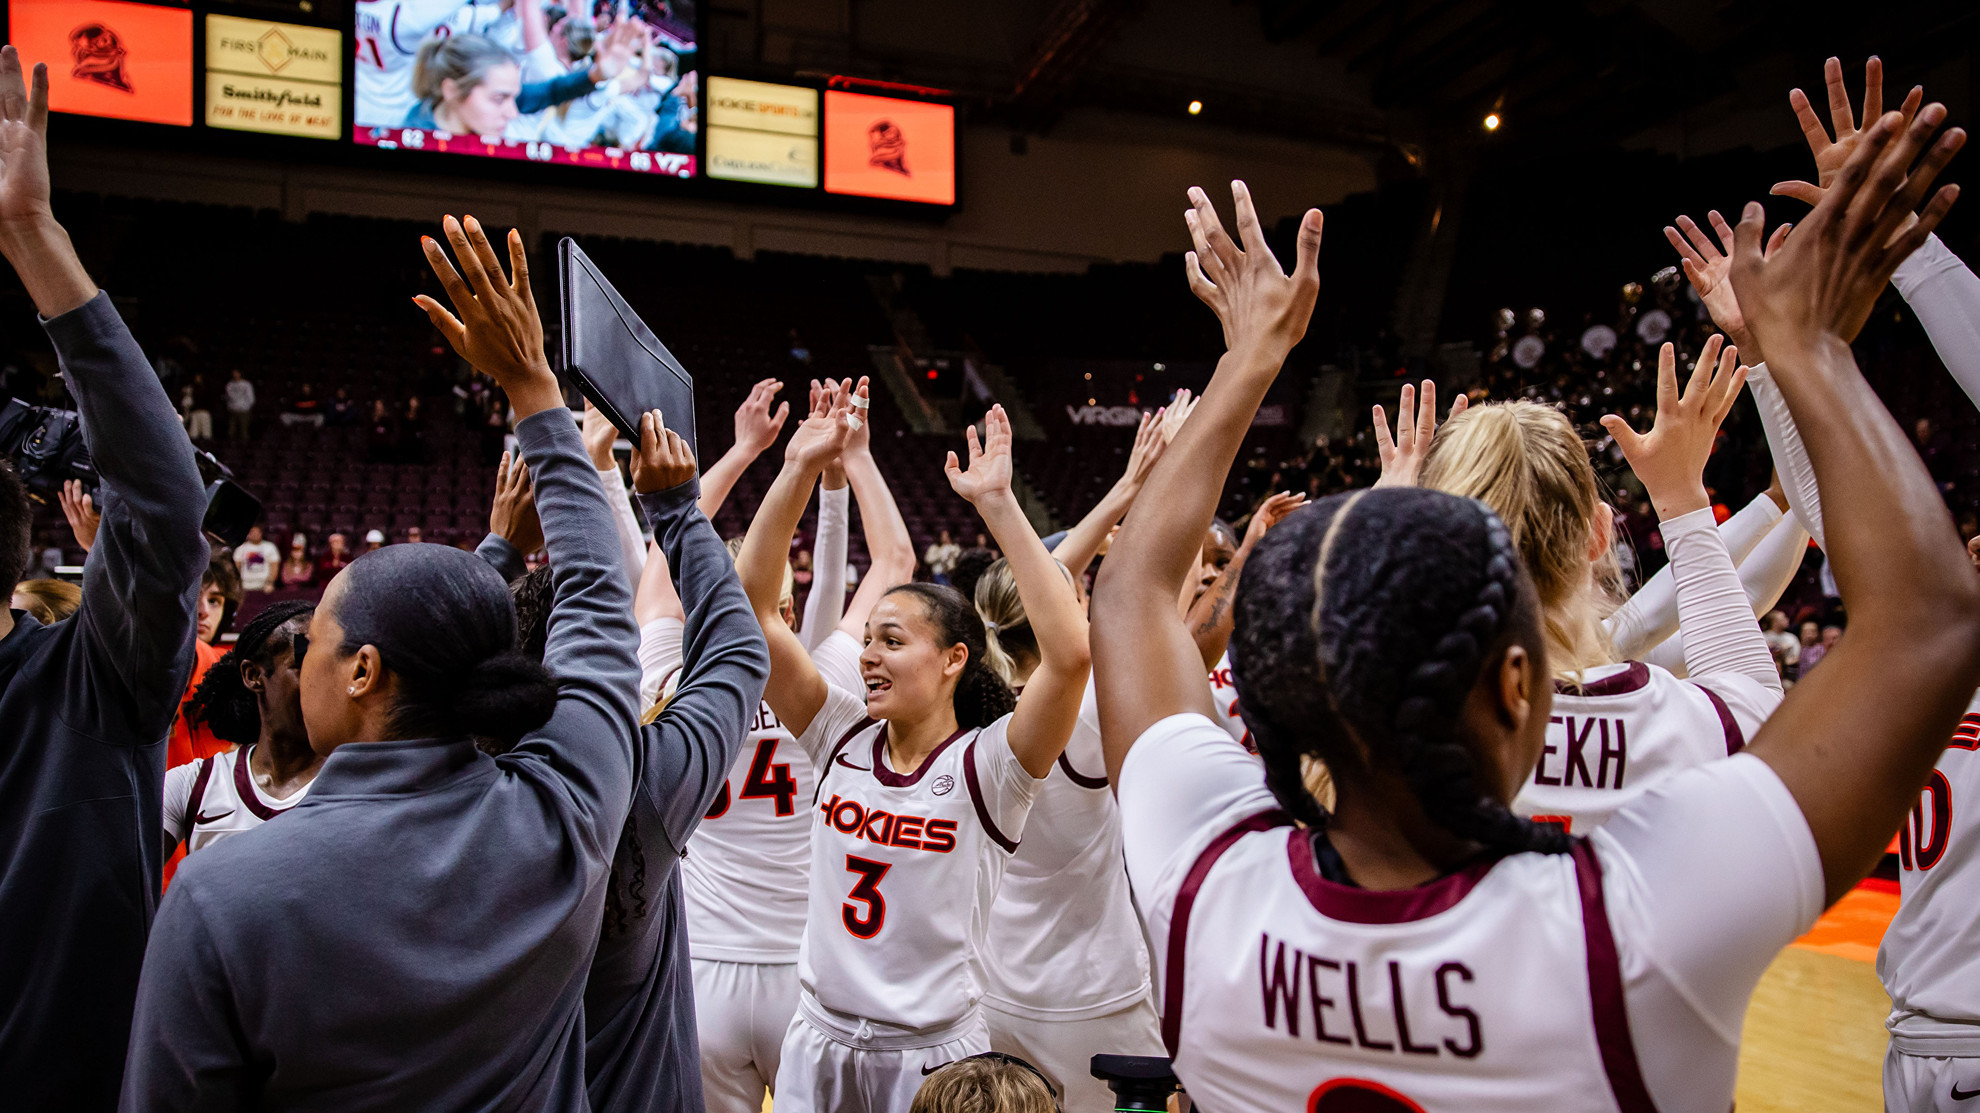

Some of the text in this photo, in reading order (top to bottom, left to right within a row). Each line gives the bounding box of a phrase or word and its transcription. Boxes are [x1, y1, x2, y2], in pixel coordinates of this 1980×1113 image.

[287, 47, 328, 62] MAIN
[222, 84, 322, 107] Smithfield
[260, 109, 285, 123] LOVE
[654, 152, 690, 174] VT
[703, 738, 798, 819] 4
[1534, 715, 1627, 791] EKH
[820, 793, 958, 853] HOKIES
[842, 853, 892, 939] 3
[1260, 931, 1484, 1060] WELLS
